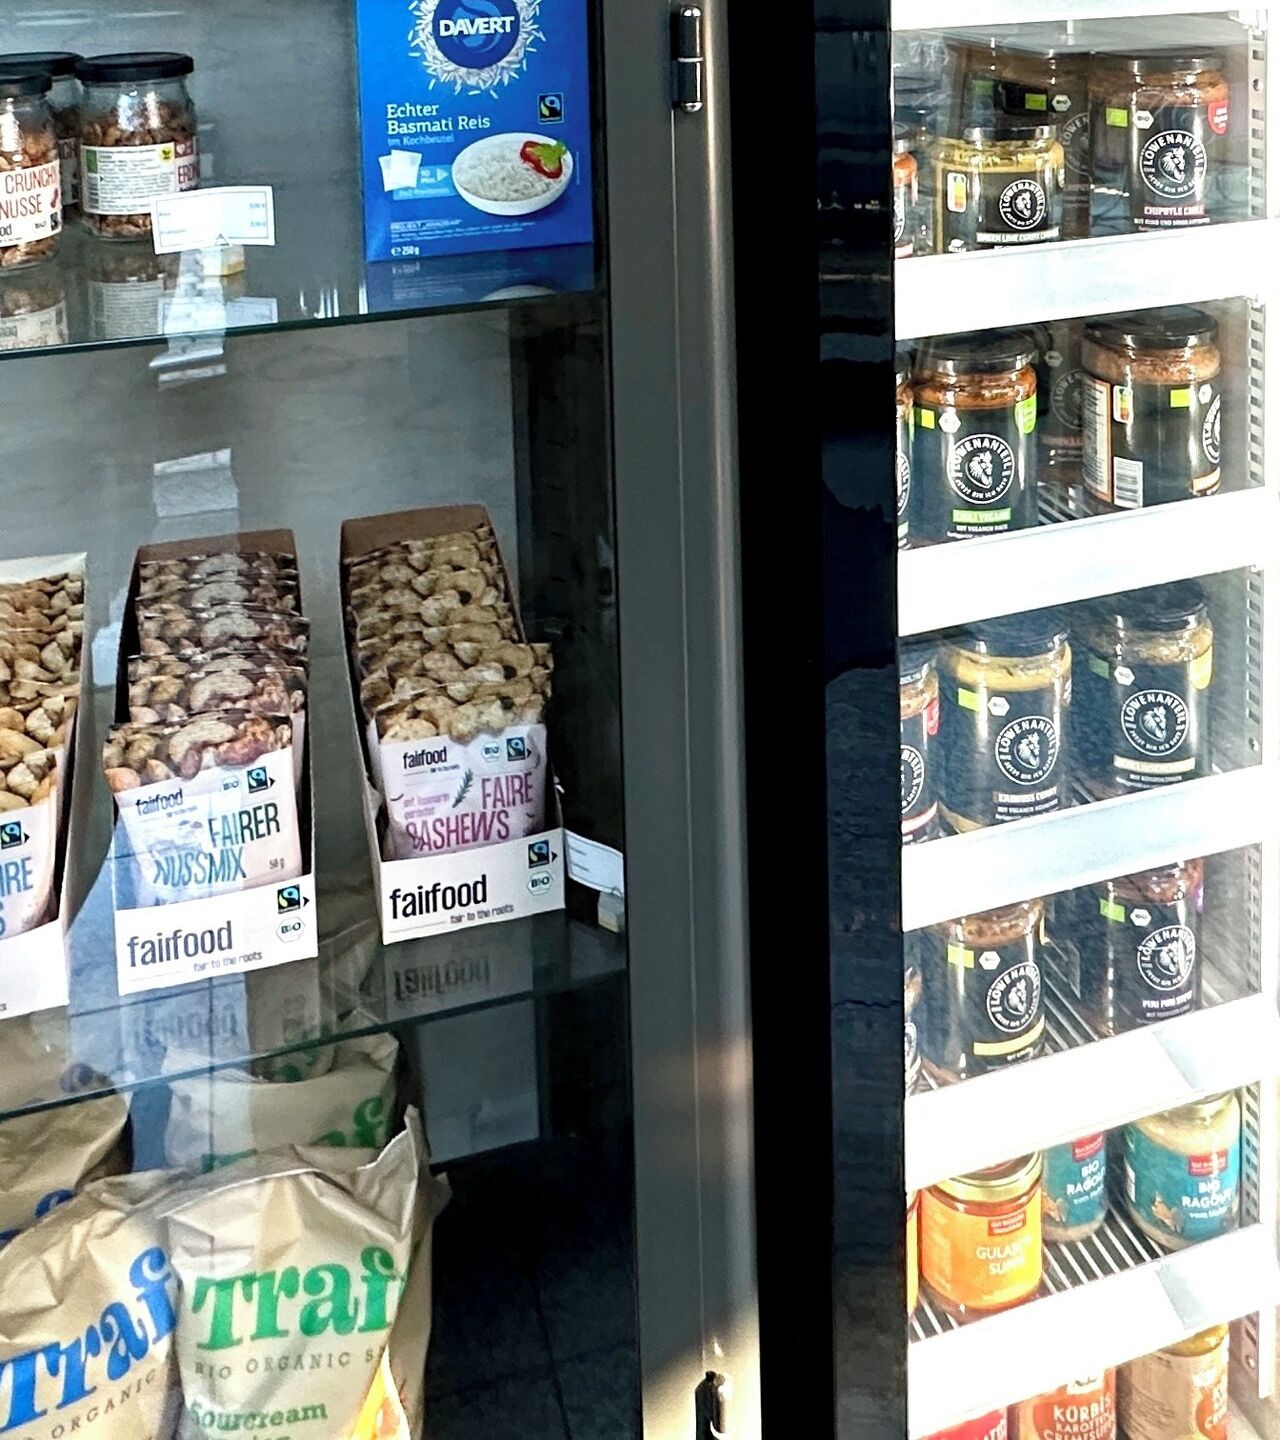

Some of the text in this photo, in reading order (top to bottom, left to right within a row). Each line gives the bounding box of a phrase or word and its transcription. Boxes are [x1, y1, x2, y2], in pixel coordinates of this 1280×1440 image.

[439, 15, 515, 37] DAVERT
[386, 102, 439, 119] Echter
[387, 115, 491, 135] Basmati Reis
[403, 746, 448, 770] fairfood
[135, 788, 183, 816] fairfood
[481, 772, 534, 810] FAIRE
[208, 802, 281, 849] FAIRER
[153, 846, 247, 888] NUSSMIX
[389, 873, 488, 920] fairfood
[450, 902, 514, 925] fair to the roots
[127, 920, 233, 968] fairfood
[238, 950, 263, 964] roots
[191, 1245, 400, 1352] Traf
[246, 1351, 351, 1374] ORGANIC
[189, 1399, 329, 1432] Sourcream
